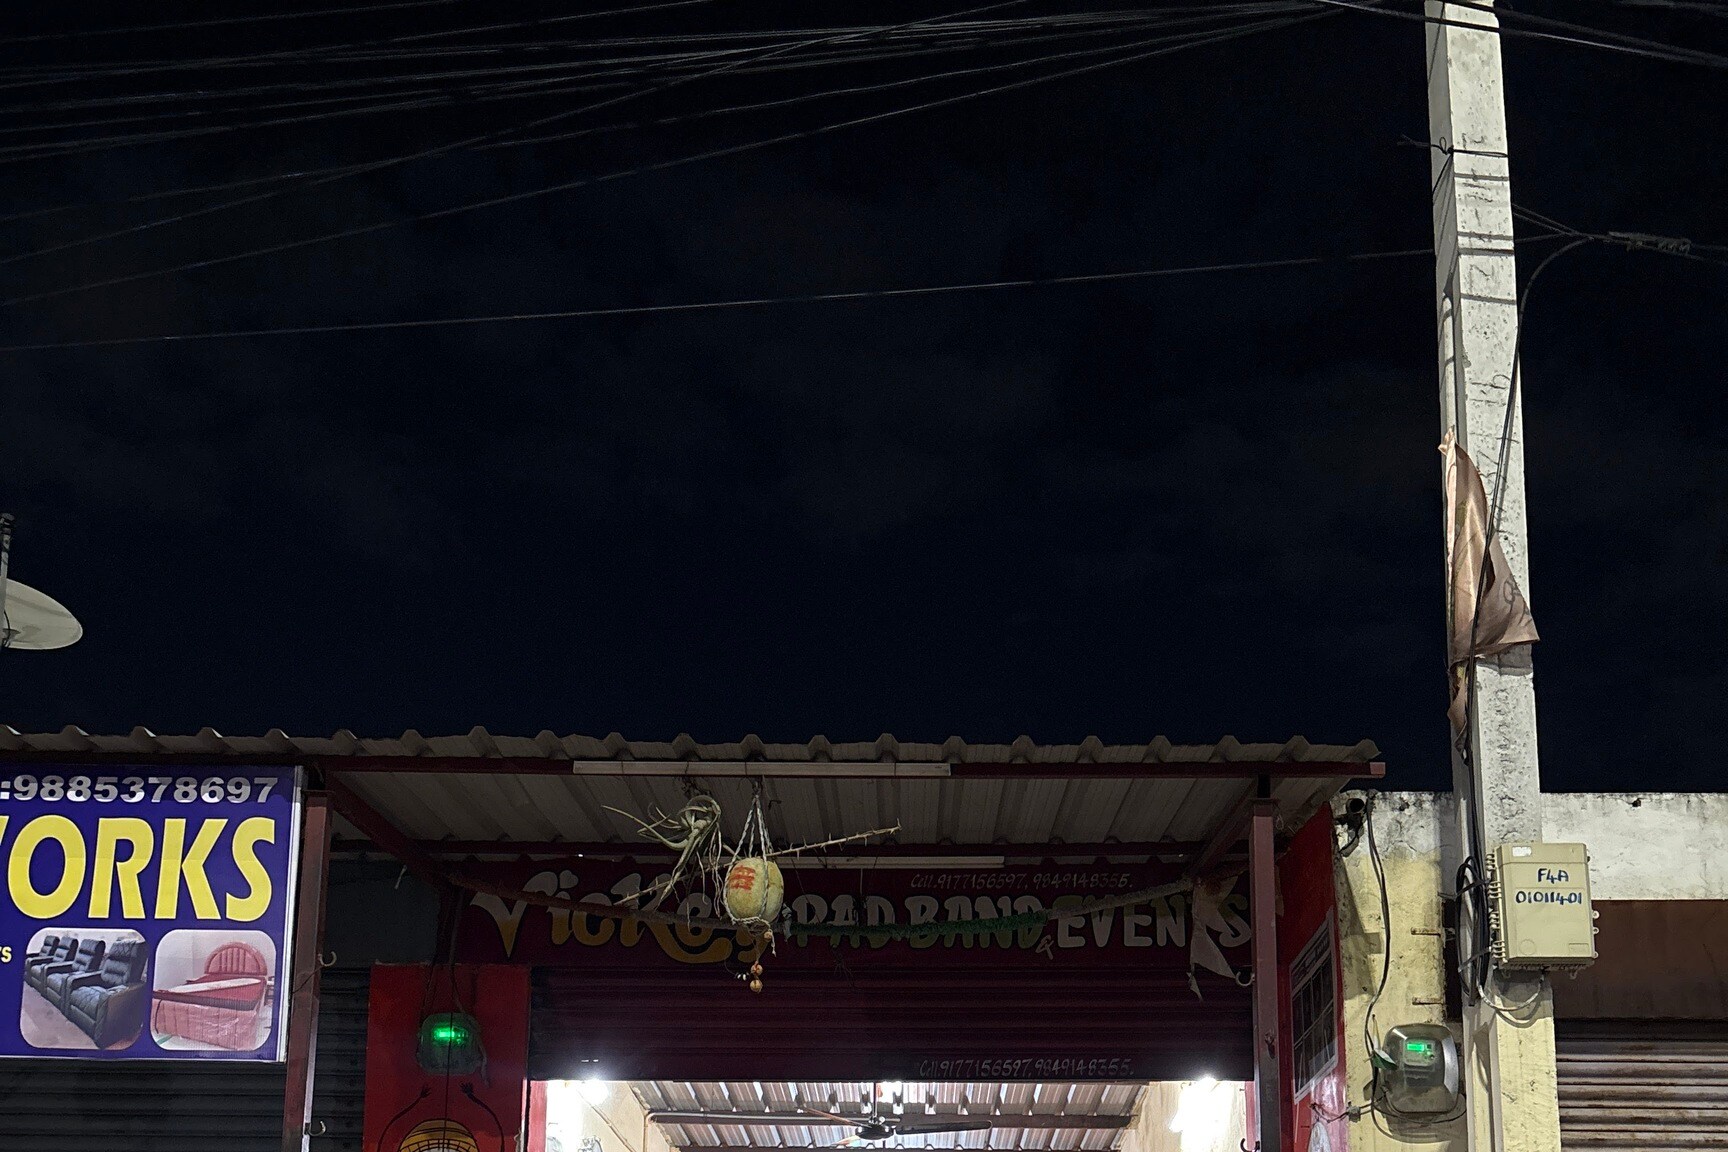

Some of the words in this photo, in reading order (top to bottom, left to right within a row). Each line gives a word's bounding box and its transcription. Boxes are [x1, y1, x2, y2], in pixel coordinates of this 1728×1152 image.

[0, 815, 275, 922] ORKS
[1537, 867, 1570, 884] F4A
[1516, 891, 1582, 905] 01011401
[791, 893, 896, 949] PAD
[904, 893, 1046, 949] BAND
[1052, 893, 1252, 949] EVENS
